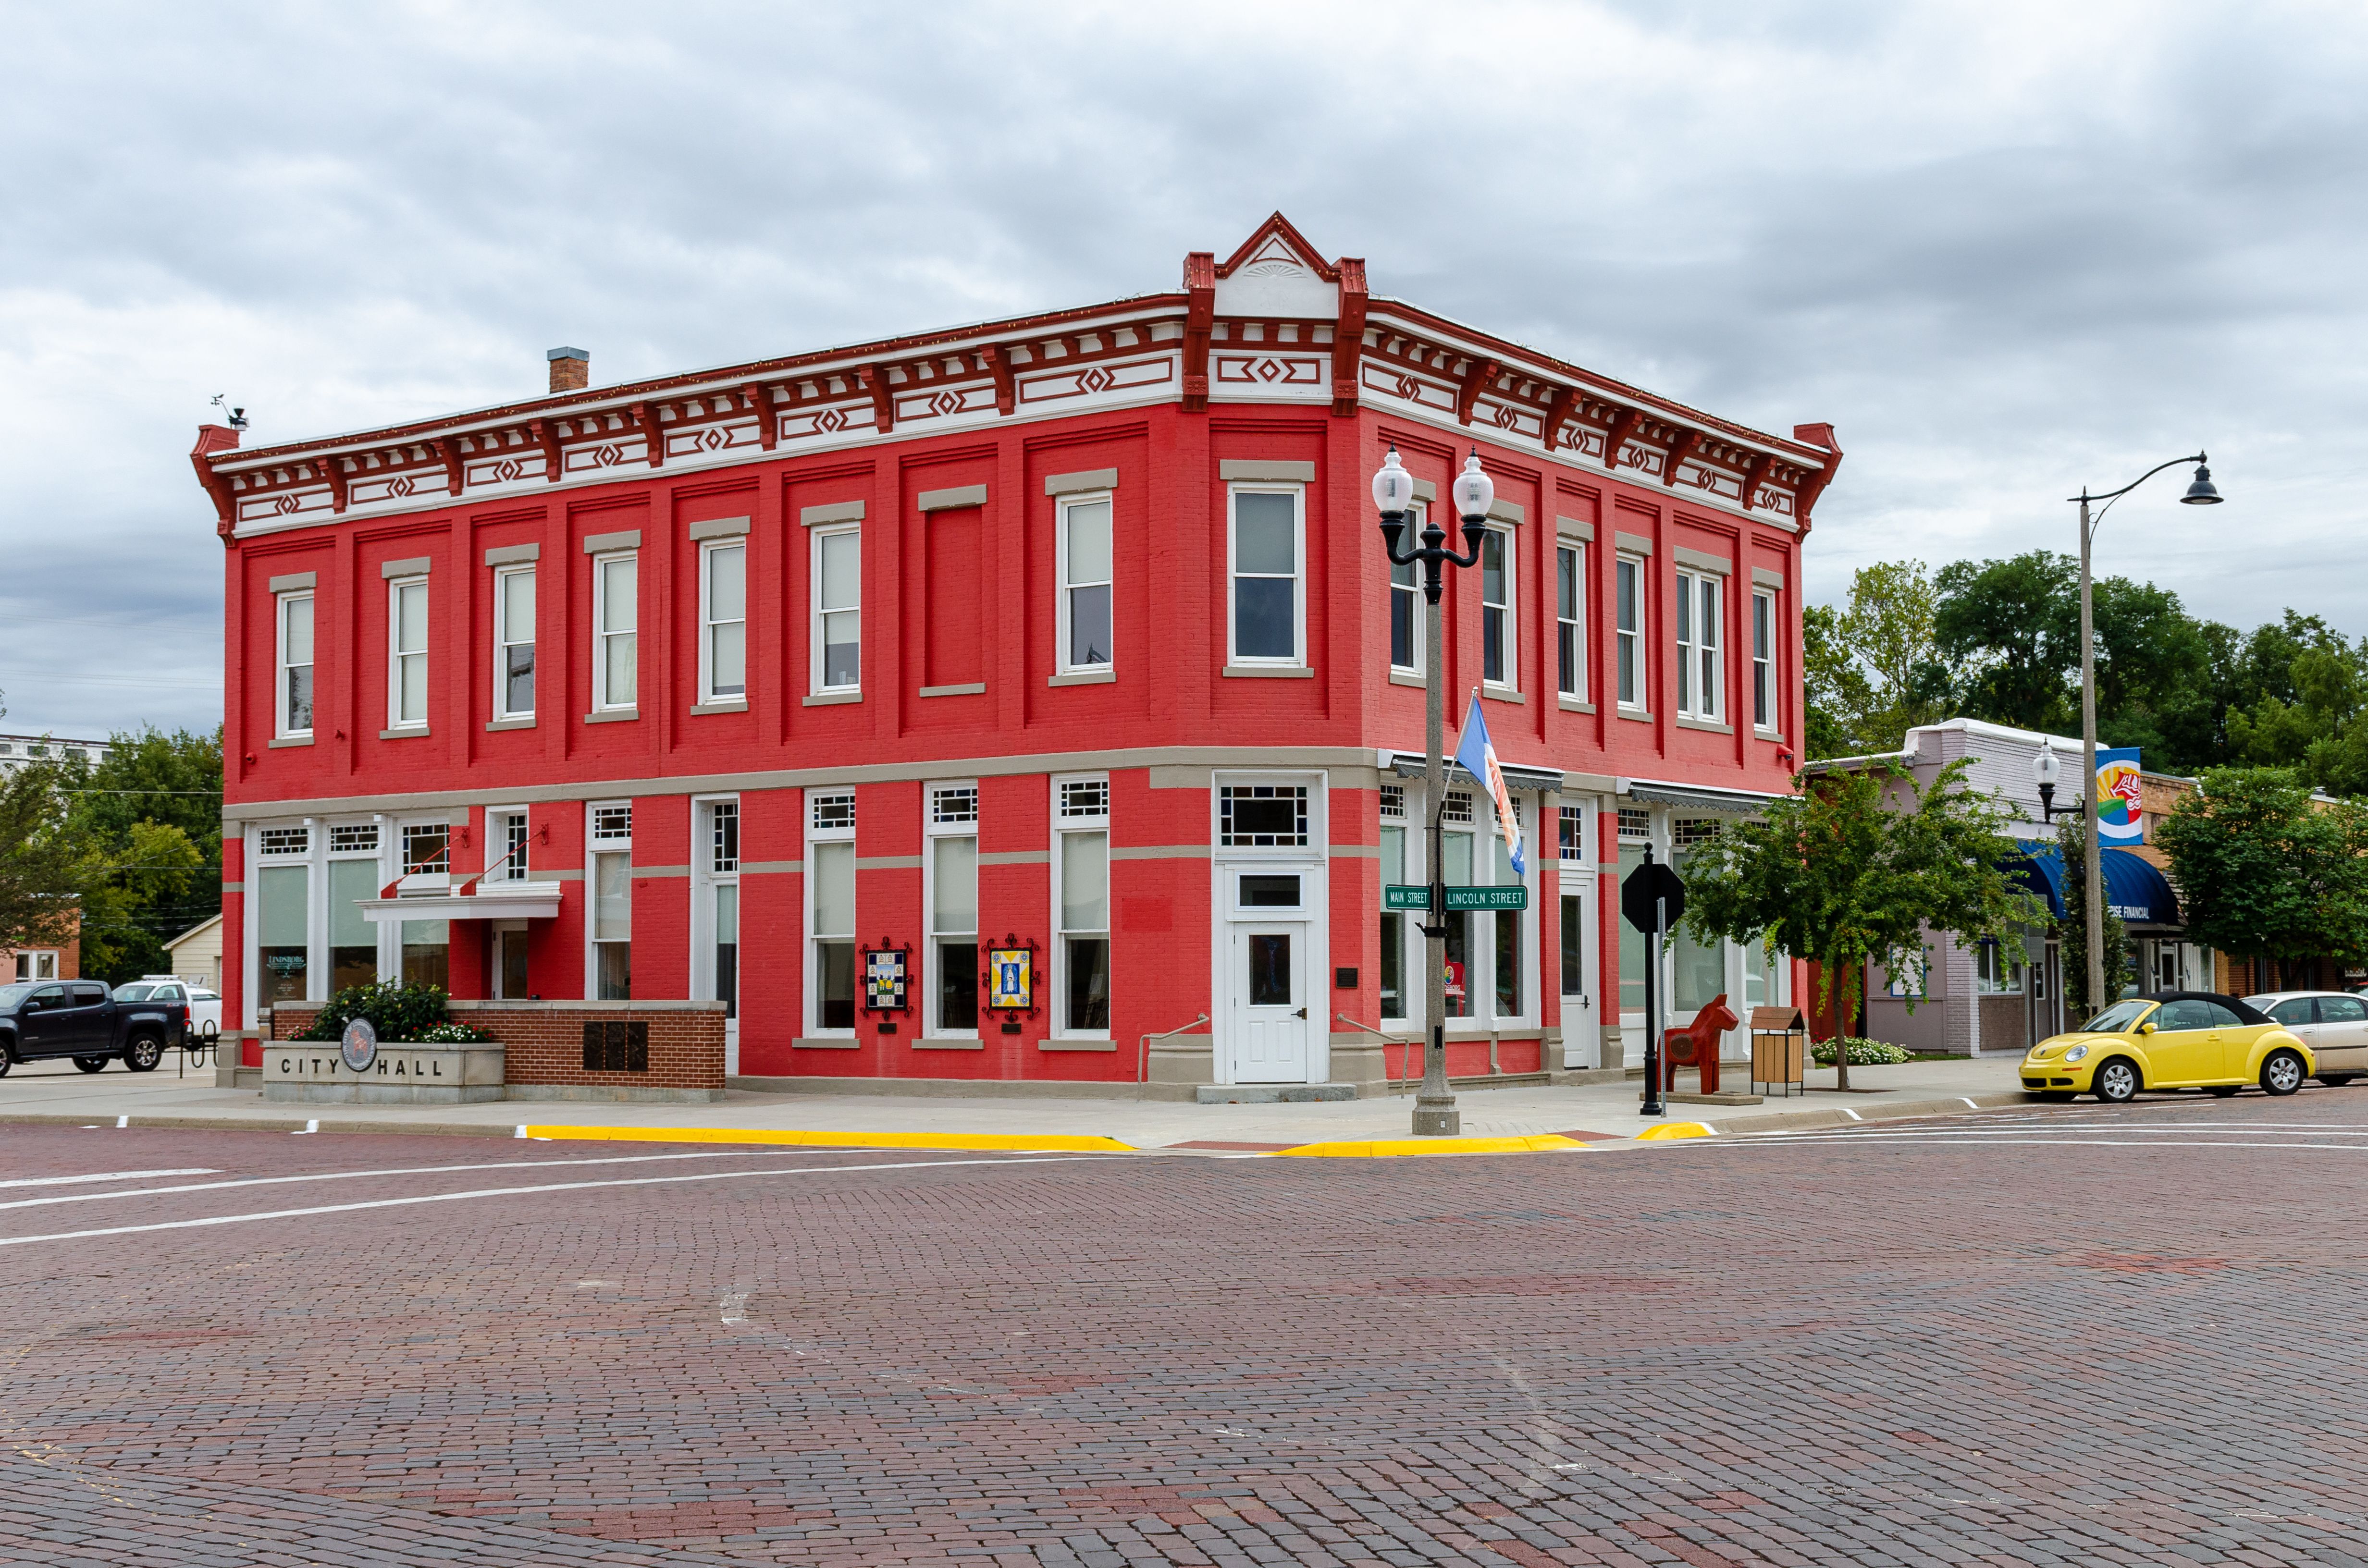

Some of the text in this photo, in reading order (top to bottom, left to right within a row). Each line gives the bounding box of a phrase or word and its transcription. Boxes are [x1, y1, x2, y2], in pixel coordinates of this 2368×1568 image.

[1390, 892, 1427, 903] MAIN STREET
[1448, 893, 1522, 904] LINCOLN STREET
[2123, 906, 2149, 919] FINANCIAL
[282, 1058, 442, 1076] CITY HALL
